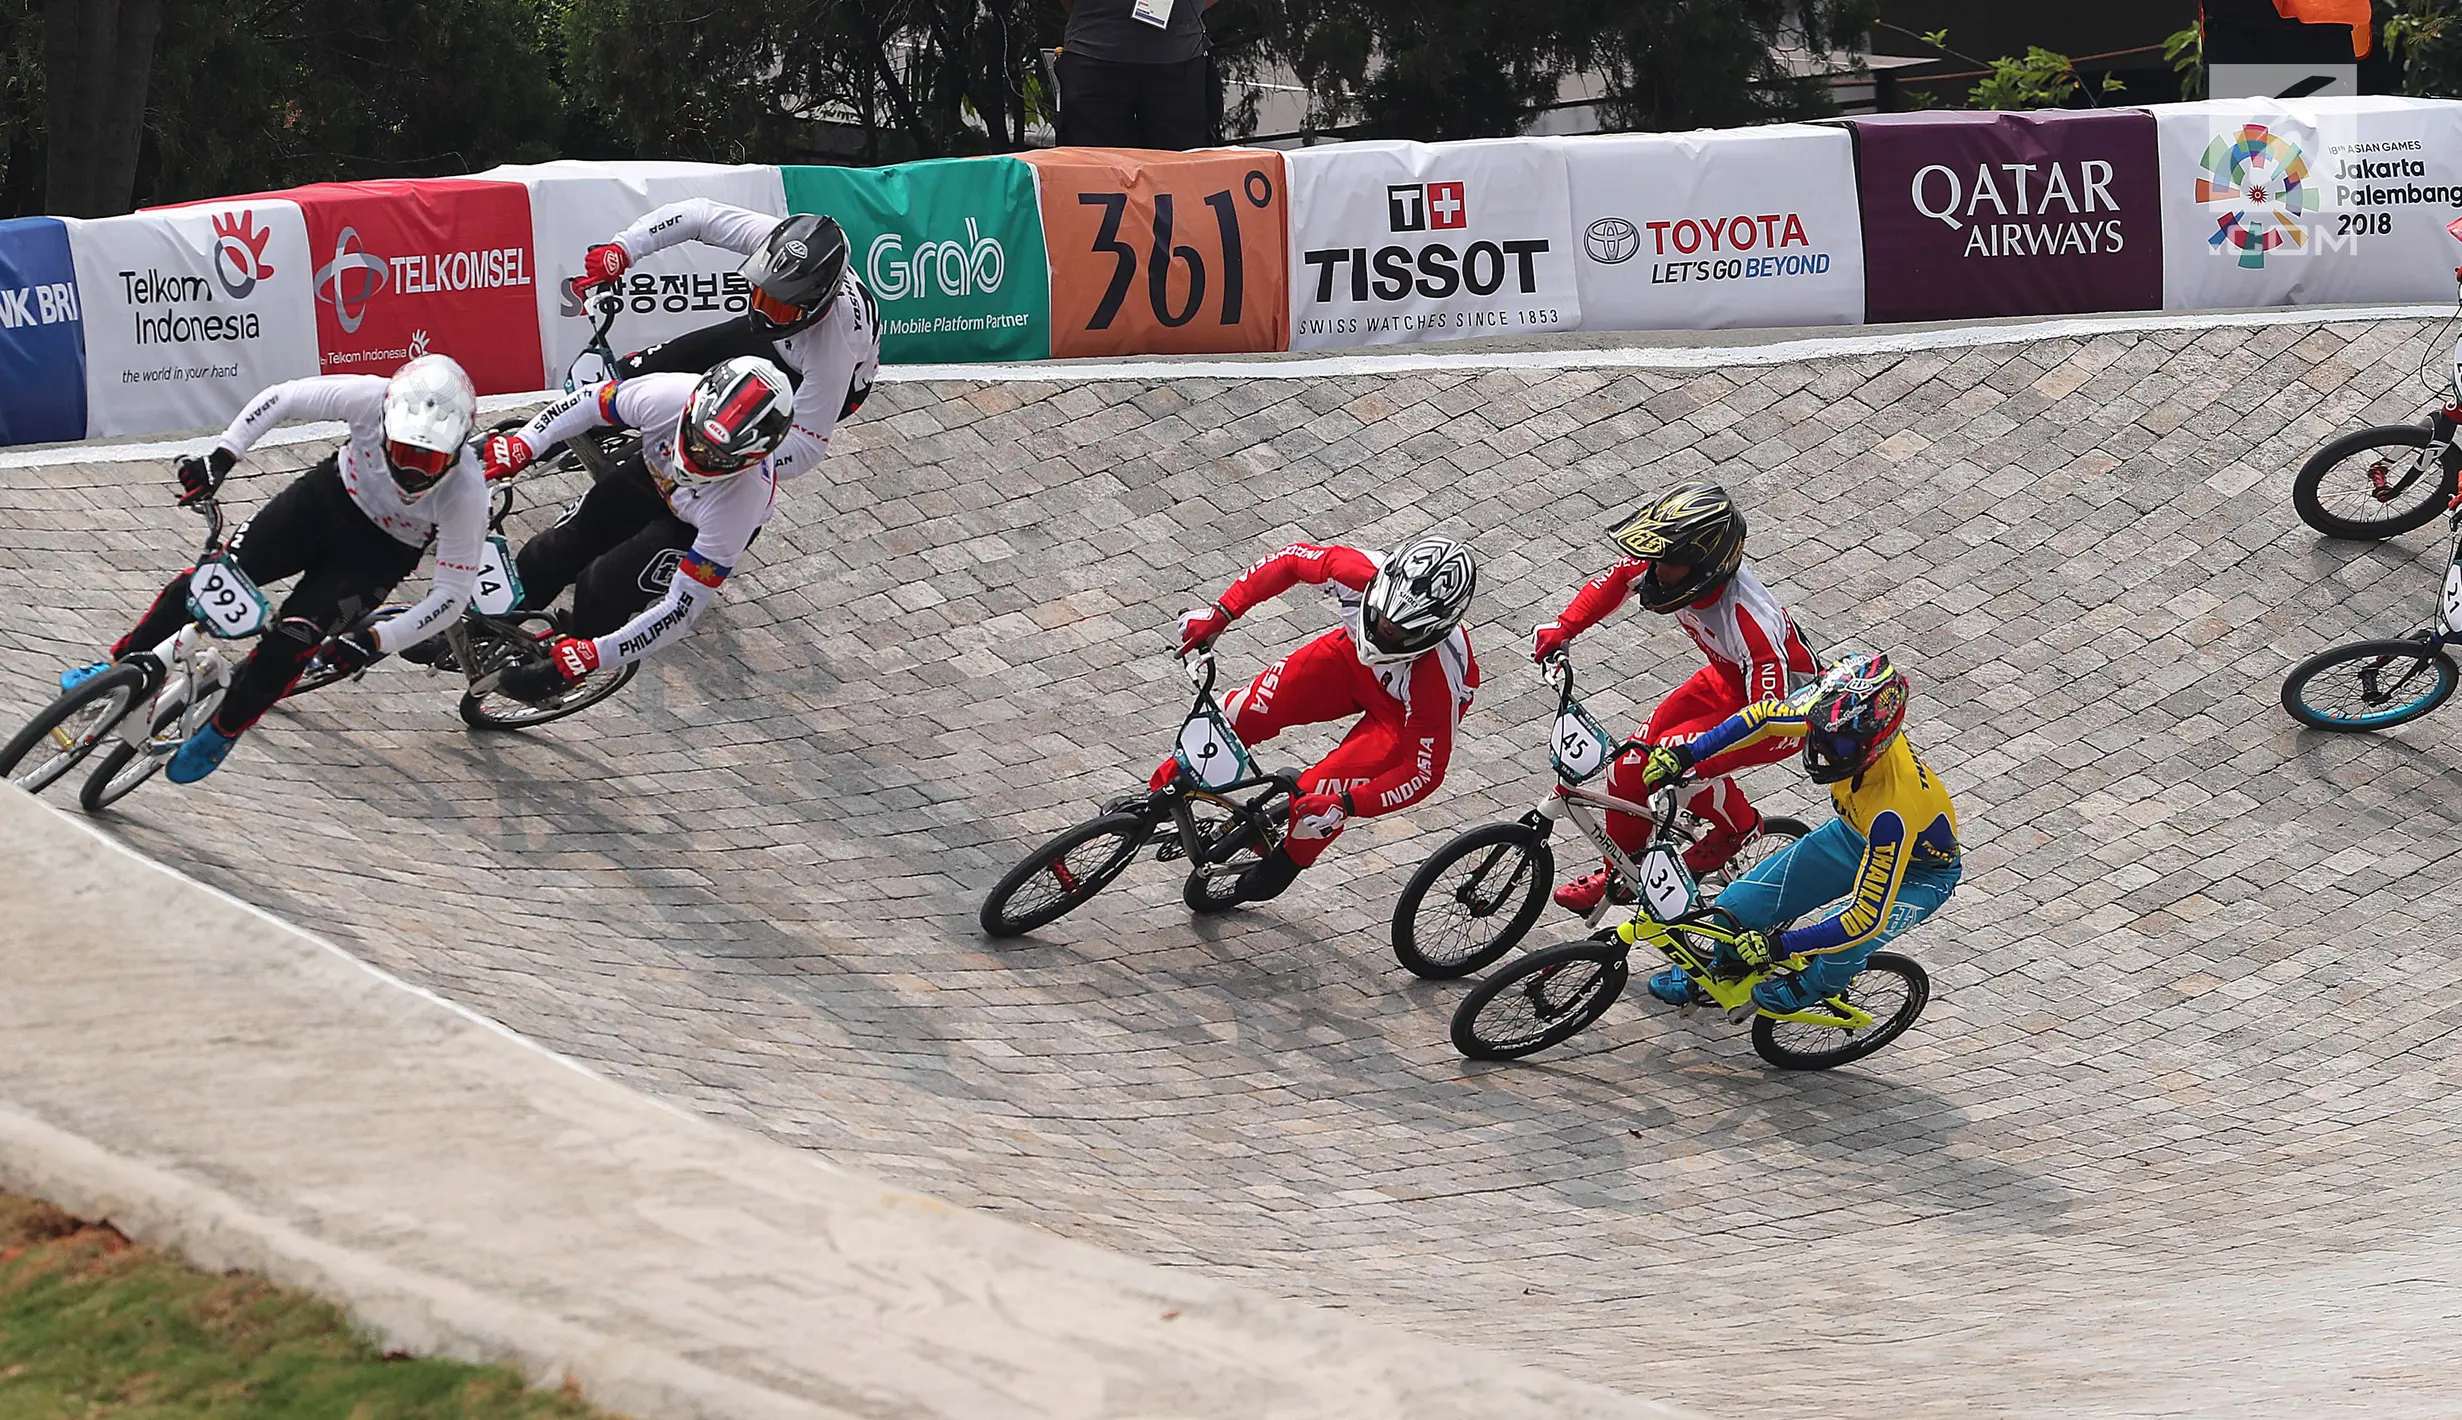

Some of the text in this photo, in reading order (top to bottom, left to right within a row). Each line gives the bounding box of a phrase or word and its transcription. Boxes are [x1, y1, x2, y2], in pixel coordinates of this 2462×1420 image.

[2347, 143, 2381, 154] ASIAN
[2381, 140, 2422, 152] GAMES
[2334, 158, 2425, 180] Jakarta
[1910, 159, 2121, 230] QATAR
[2336, 182, 2462, 208] Palembang
[1645, 212, 1811, 256] TOYOTA
[1963, 220, 2124, 258] AIRWAYS
[2337, 212, 2392, 236] 2018
[389, 247, 531, 295] TELKOMSEL
[866, 216, 1005, 301] Grab
[1304, 239, 1551, 304] TISSOT
[1651, 253, 1831, 285] LET'S GO BEYOND
[35, 281, 79, 325] BRI
[118, 269, 213, 304] Telkom
[135, 308, 260, 345] Indonesia
[890, 318, 932, 335] Mobile
[933, 314, 983, 333] Platform
[984, 312, 1029, 330] Partner
[1299, 308, 1560, 335] SWISS WATCHES SINCE 1853
[327, 351, 361, 365] Telkom
[362, 346, 407, 361] Indonesia
[122, 363, 238, 383] the world in your hand
[708, 422, 728, 441] BELL
[476, 564, 502, 597] 14
[201, 575, 248, 623] 993
[2447, 582, 2461, 615] 21
[561, 646, 587, 676] FOX
[1196, 742, 1219, 759] 9
[1562, 731, 1589, 760] 45
[1380, 737, 1435, 808] INDONSIA
[1590, 823, 1625, 866] THRILL
[1649, 868, 1676, 902] 31
[1839, 841, 1897, 937] THAILAND
